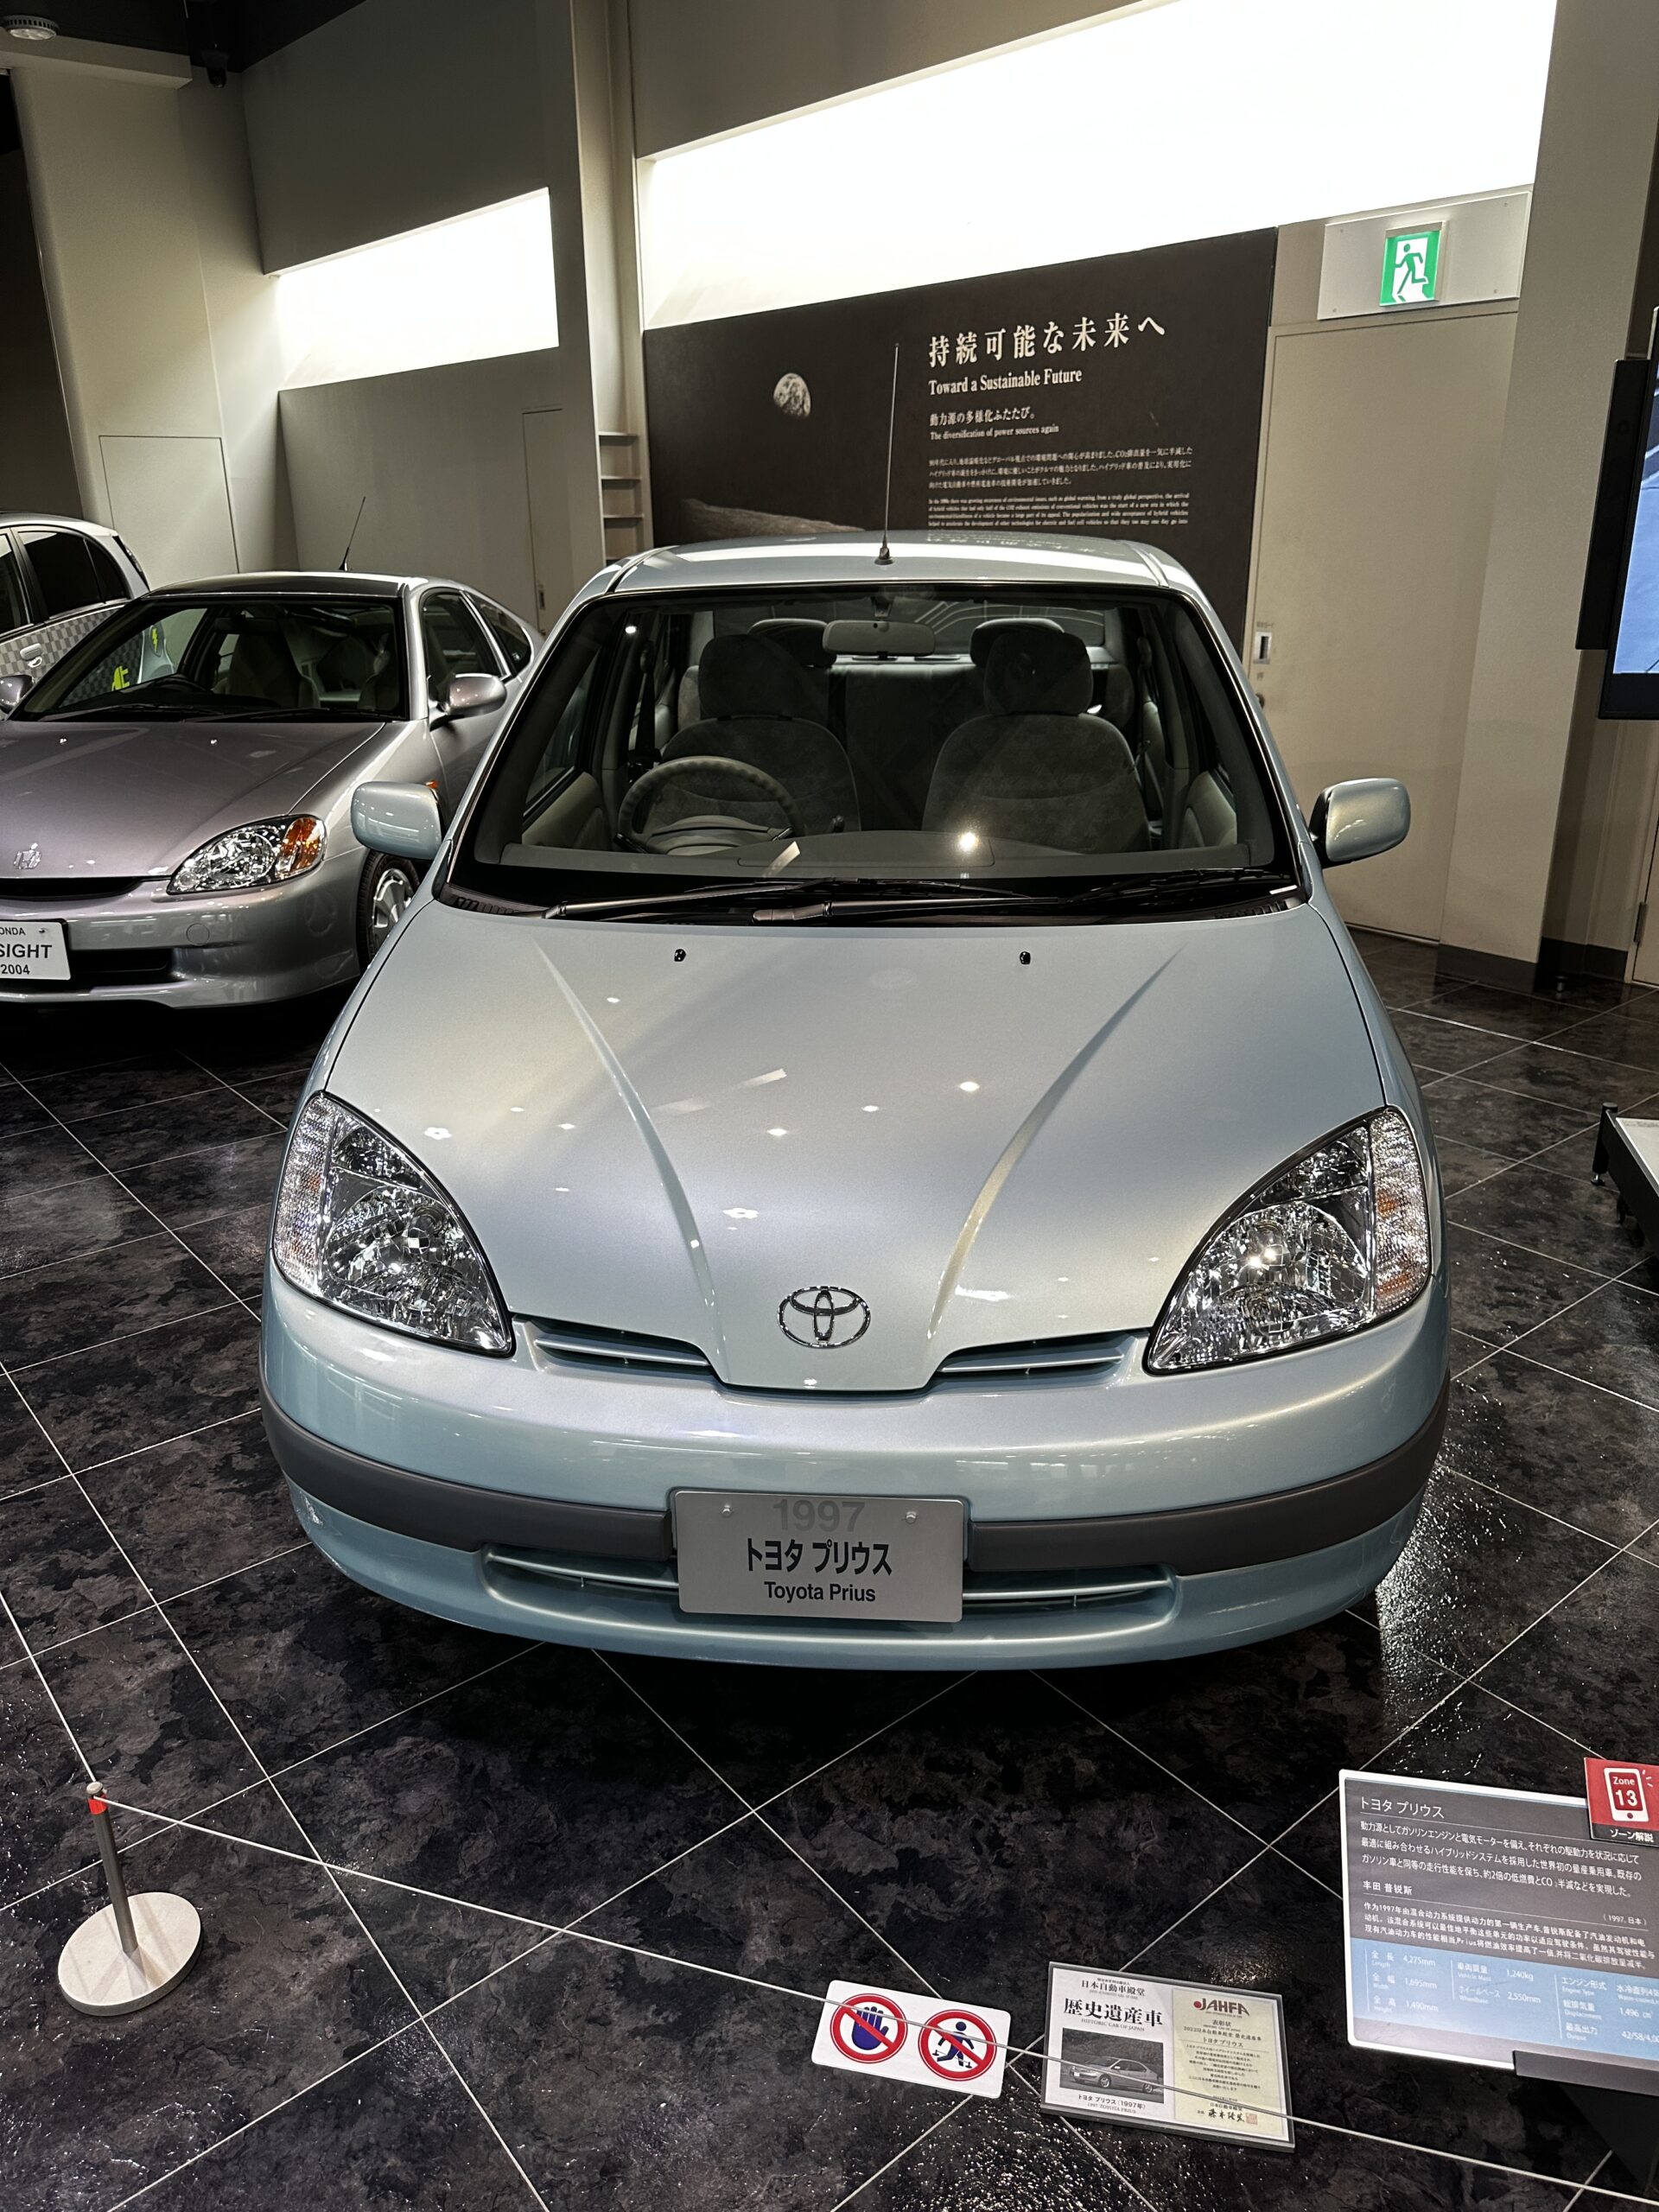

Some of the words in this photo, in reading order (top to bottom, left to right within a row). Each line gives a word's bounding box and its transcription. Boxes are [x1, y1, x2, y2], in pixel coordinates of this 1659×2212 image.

[929, 312, 1166, 368] 持続可能な未来へ
[928, 377, 968, 396] Toward
[970, 381, 977, 392] a
[980, 370, 1040, 391] Sustainable
[1043, 367, 1083, 385] Future
[943, 429, 984, 439] diversification
[986, 427, 993, 436] of
[994, 428, 1014, 438] power
[1015, 426, 1039, 435] sources
[1040, 423, 1059, 434] again
[0, 927, 26, 936] ONDA
[1, 963, 30, 975] 2004
[773, 1499, 865, 1532] 1997
[747, 1538, 804, 1572] トヨタ
[811, 1539, 893, 1576] プリウス
[764, 1581, 823, 1603] Toyota
[830, 1583, 876, 1602] Prius
[1612, 1777, 1636, 1785] Zone
[1615, 1789, 1638, 1806] 13
[1361, 1796, 1393, 1812] トヨタ
[1396, 1801, 1445, 1819] プリウス
[1610, 1829, 1654, 1843] ゾーン解説
[1363, 1880, 1381, 1891] 丰田
[1383, 1883, 1413, 1896] 普锐斯
[1082, 1980, 1145, 1996] 日本自動車殿堂
[1064, 1998, 1163, 2027] 歴史遺産車
[1198, 1998, 1250, 2017] JAHFA
